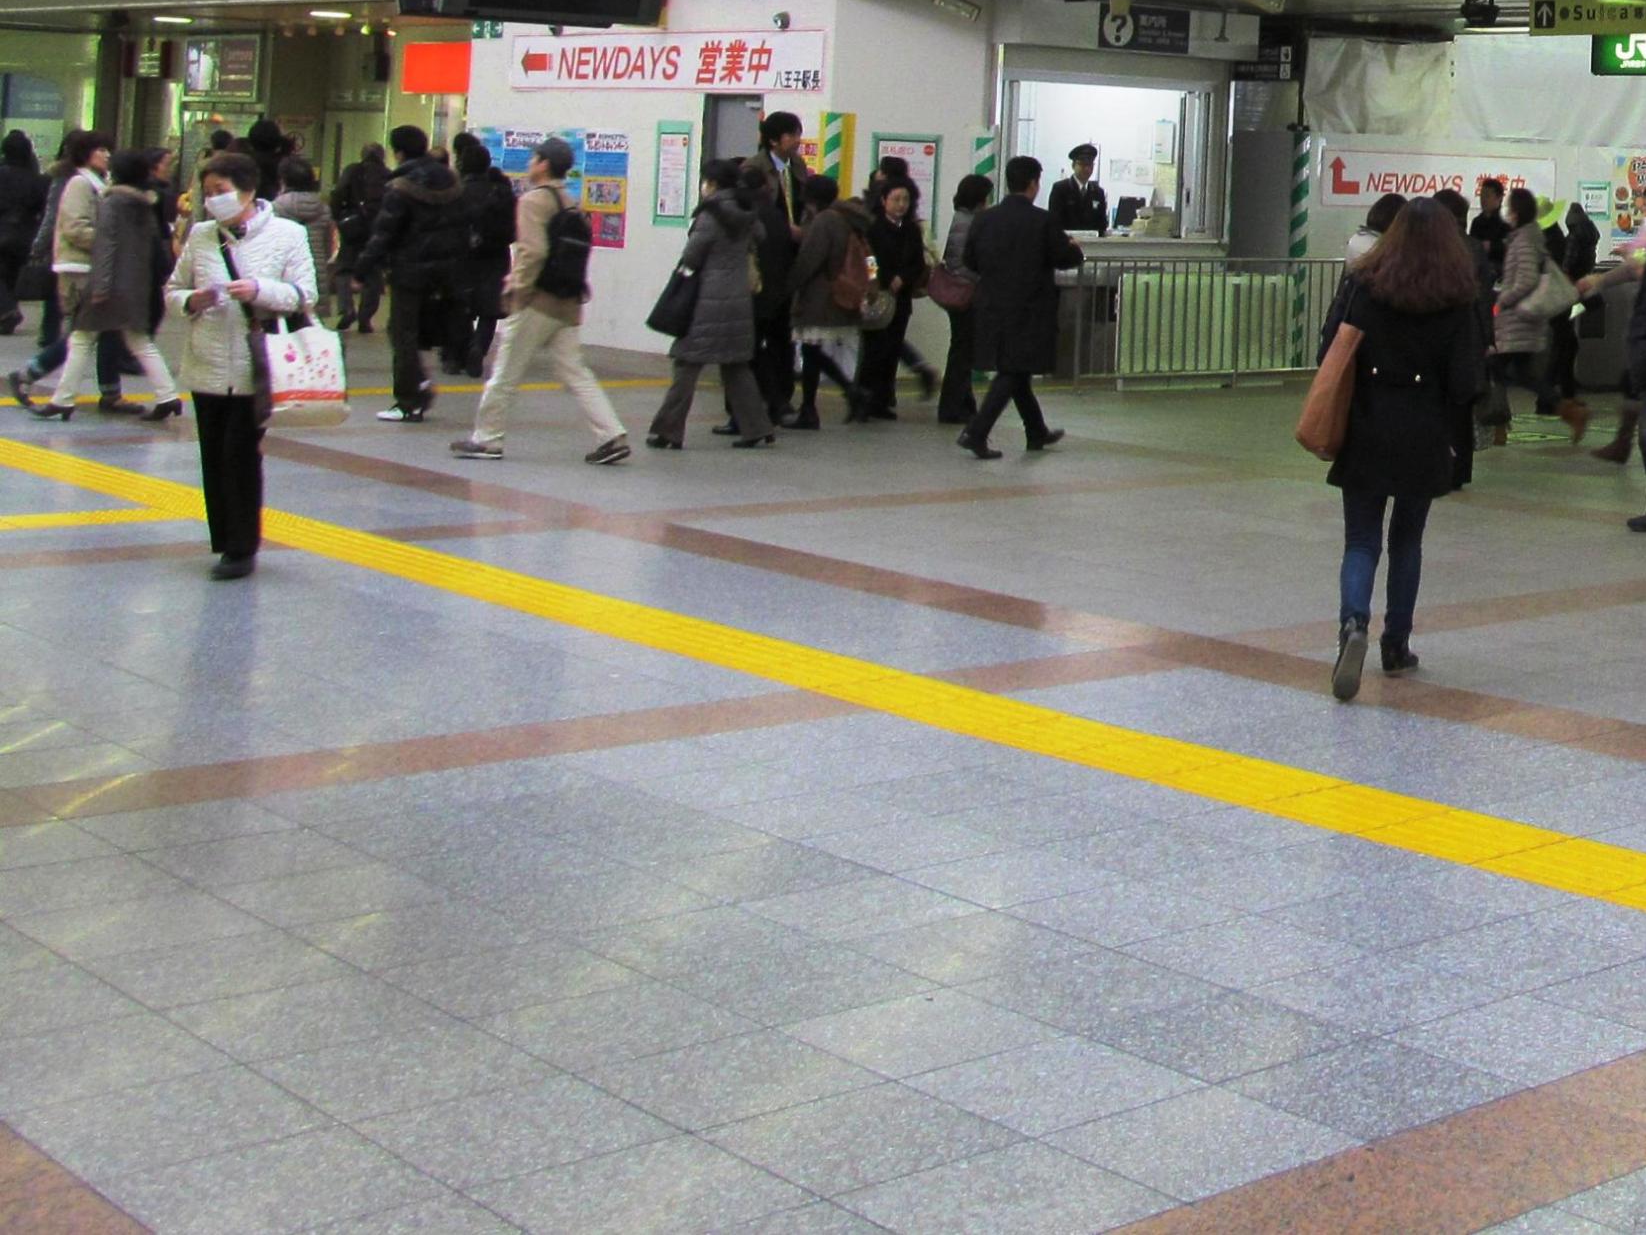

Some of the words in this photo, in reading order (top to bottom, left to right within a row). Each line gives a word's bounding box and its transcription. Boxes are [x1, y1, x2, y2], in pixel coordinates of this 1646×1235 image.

[557, 45, 682, 80] NEWDAYS
[695, 39, 773, 85] 営業中
[773, 69, 821, 90] 八王子駅長
[1366, 172, 1464, 193] NEWDAYS
